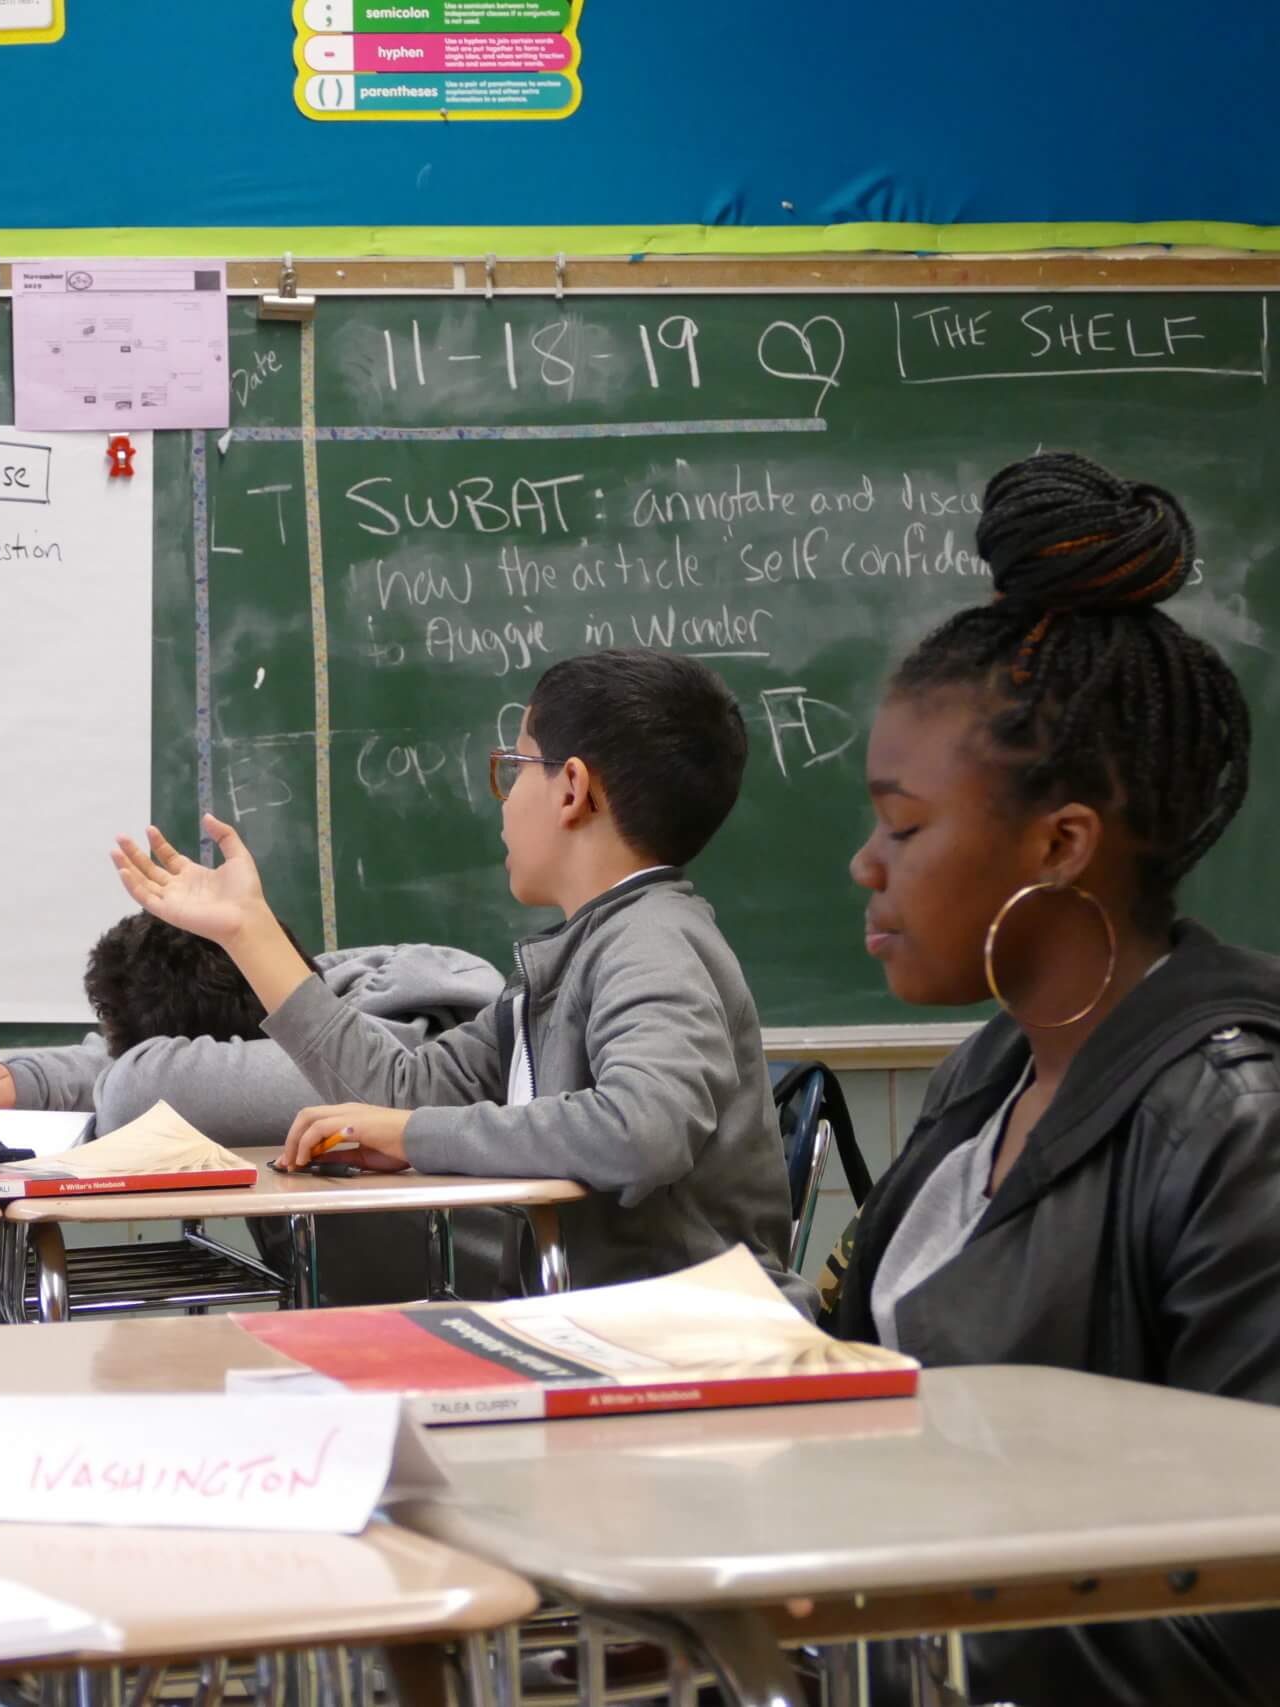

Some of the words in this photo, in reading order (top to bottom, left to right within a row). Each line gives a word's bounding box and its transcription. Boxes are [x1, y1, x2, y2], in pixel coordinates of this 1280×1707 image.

[365, 6, 430, 18] semicolon
[377, 46, 424, 61] hyphen
[360, 85, 439, 100] parentheses
[912, 305, 992, 348] THE
[1021, 305, 1206, 357] SHELF
[232, 350, 283, 408] Date
[346, 473, 606, 535] SWBAT:
[633, 465, 798, 528] annotate
[810, 474, 874, 513] and
[902, 472, 983, 516] discu
[498, 546, 558, 597] the
[573, 534, 704, 590] article
[425, 604, 550, 677] Auggie
[585, 612, 615, 647] in
[631, 603, 773, 649] Wonder
[432, 1402, 470, 1414] TALEA
[475, 1399, 521, 1413] CURRY
[30, 1427, 341, 1503] WASHINGTON
